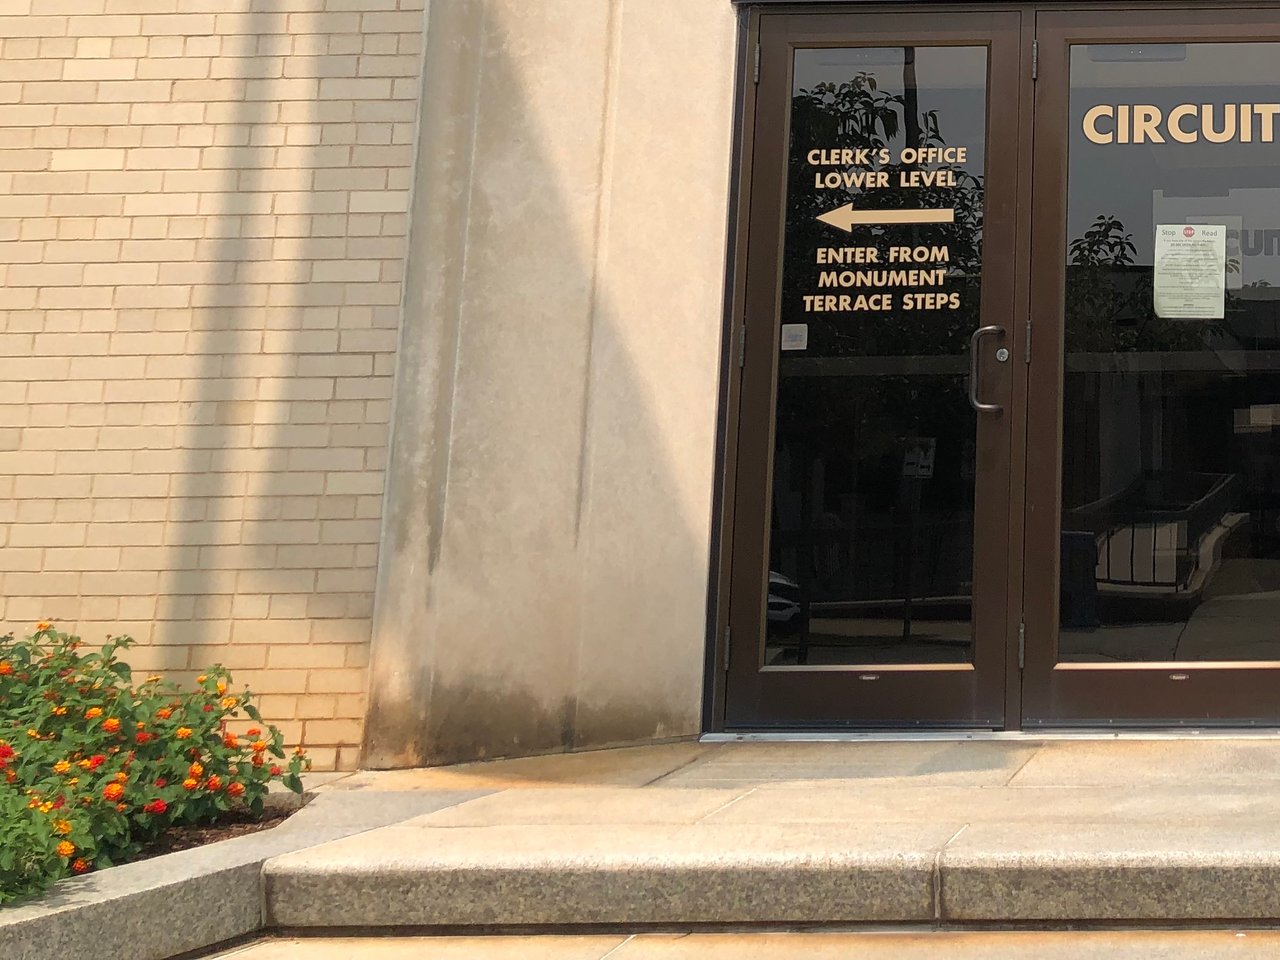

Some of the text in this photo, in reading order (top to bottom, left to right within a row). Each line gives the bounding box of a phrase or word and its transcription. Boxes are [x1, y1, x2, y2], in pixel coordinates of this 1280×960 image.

[806, 146, 968, 166] CLERK'S OFFICE
[814, 170, 958, 189] LOWER LEVEL
[1161, 229, 1177, 237] Stop
[1201, 229, 1218, 237] Read
[816, 245, 950, 265] ENTER FROM
[818, 269, 947, 288] MONUMENT
[802, 292, 961, 313] TERRACE STEPS
